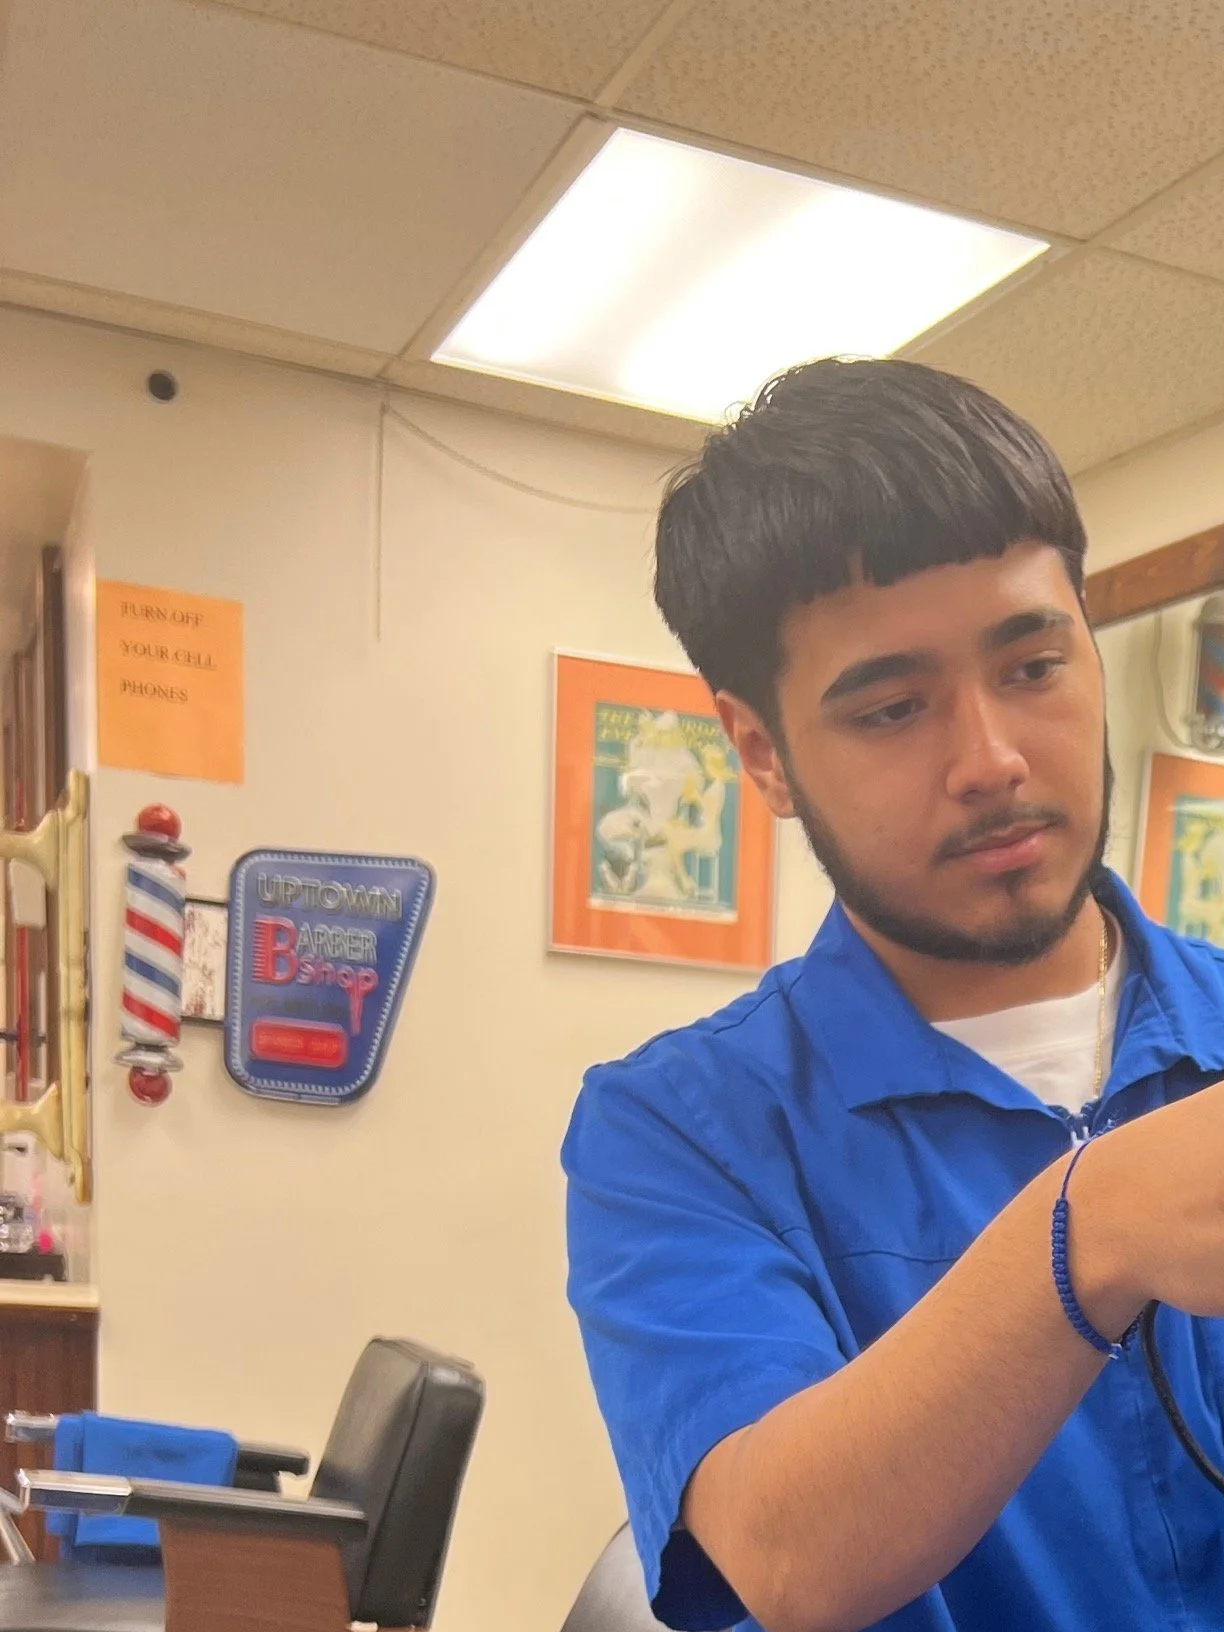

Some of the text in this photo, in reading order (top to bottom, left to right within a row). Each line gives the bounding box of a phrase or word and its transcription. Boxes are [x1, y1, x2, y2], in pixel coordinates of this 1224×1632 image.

[120, 601, 204, 628] TURN OFF
[120, 640, 217, 669] YOUR CELL
[120, 679, 188, 702] PHONES
[257, 873, 402, 920] UPTOWN
[251, 914, 378, 985] BARBER
